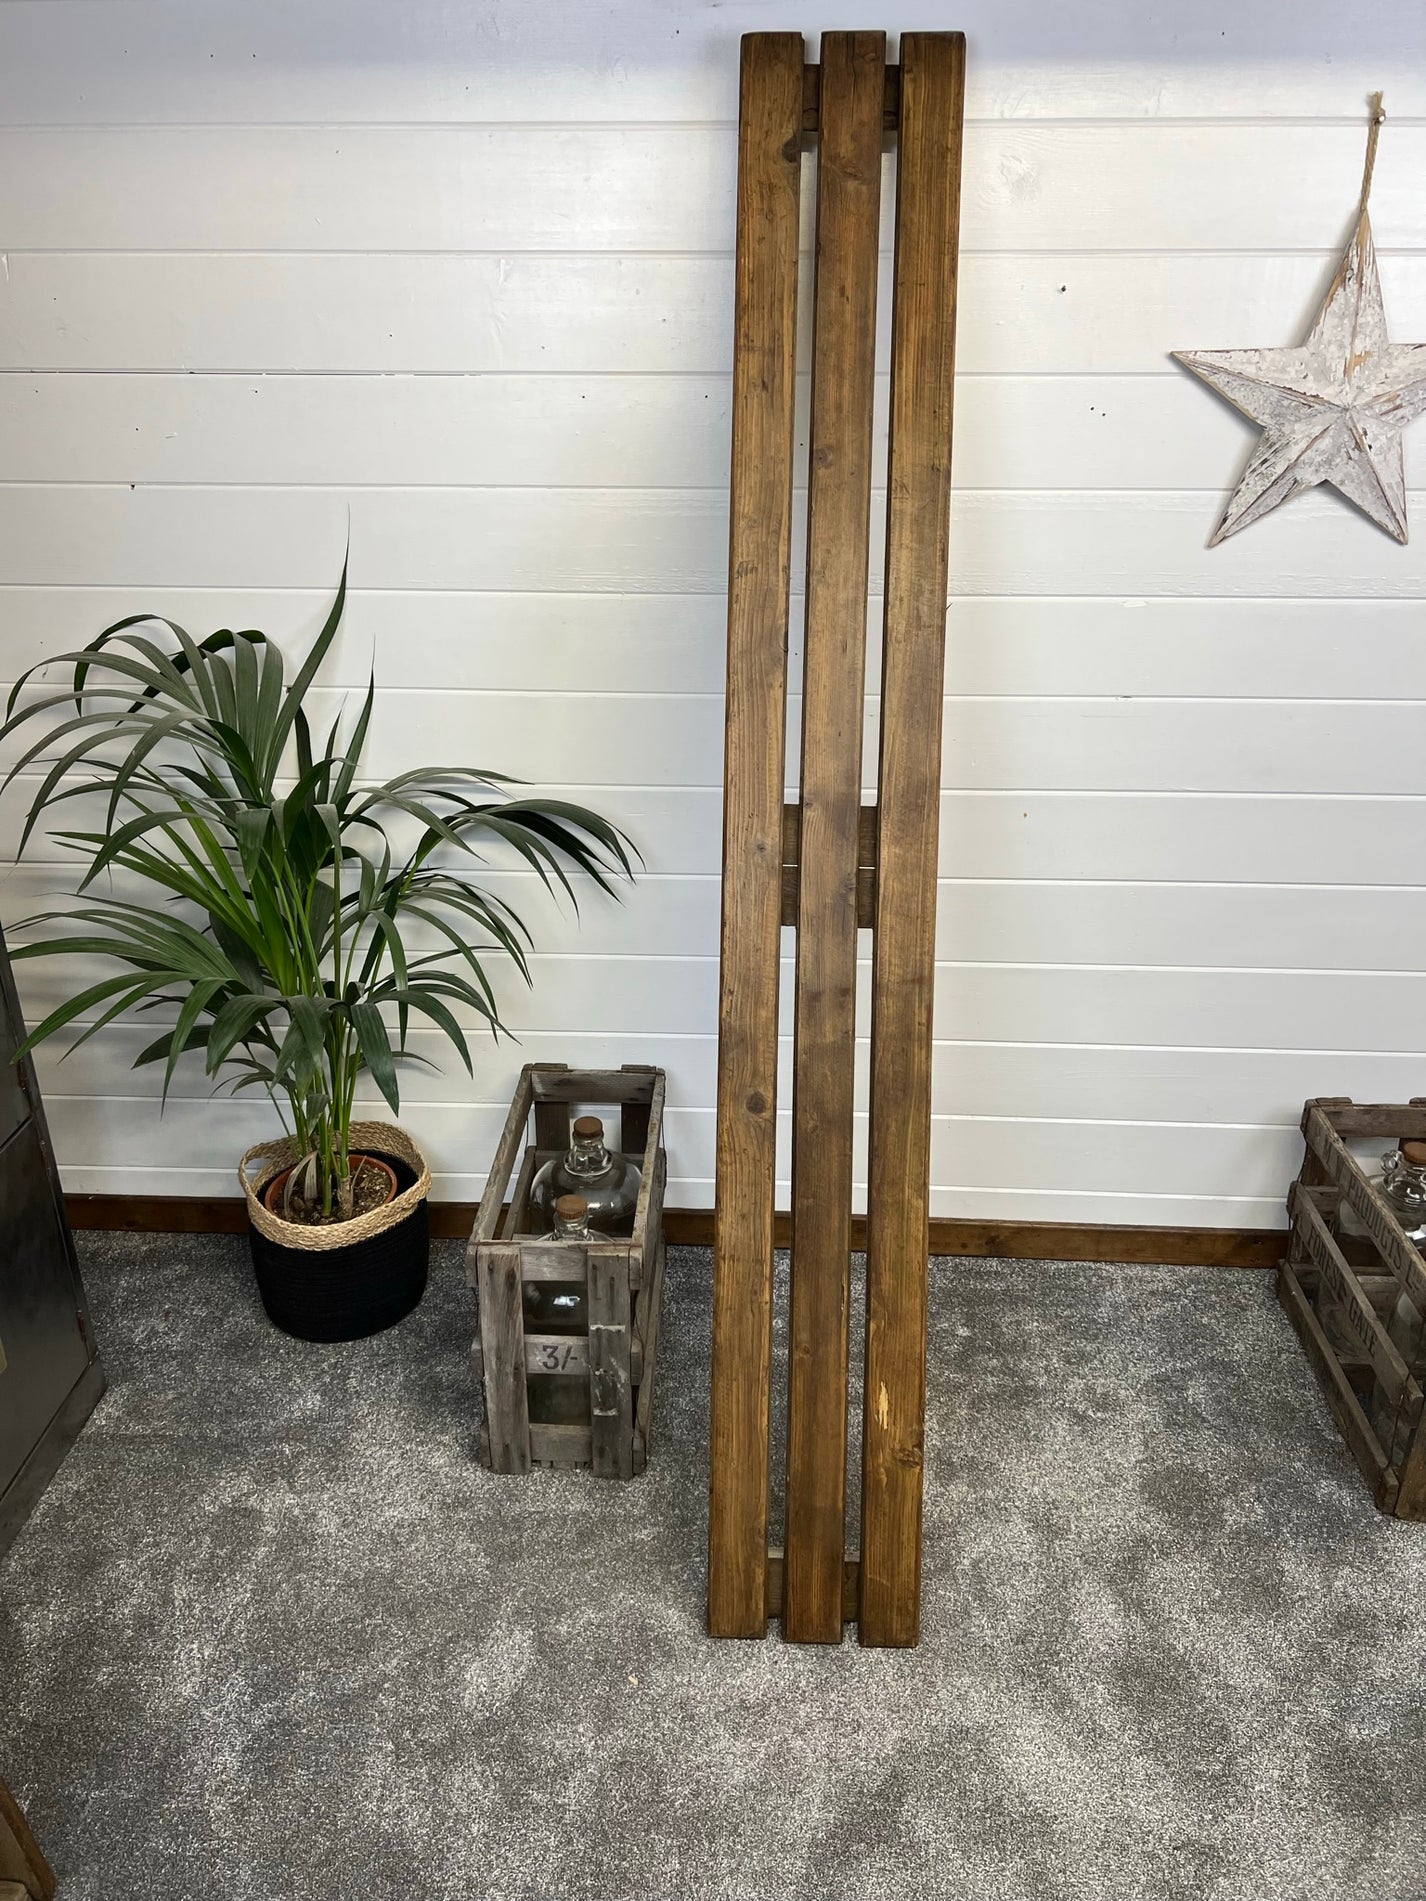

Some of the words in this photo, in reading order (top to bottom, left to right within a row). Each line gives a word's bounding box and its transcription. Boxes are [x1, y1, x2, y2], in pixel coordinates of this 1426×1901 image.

[1347, 1175, 1405, 1271] PRODUCTS
[1307, 1226, 1347, 1304] FOREST
[1348, 1297, 1378, 1359] GATE
[542, 1345, 578, 1371] 3/-
